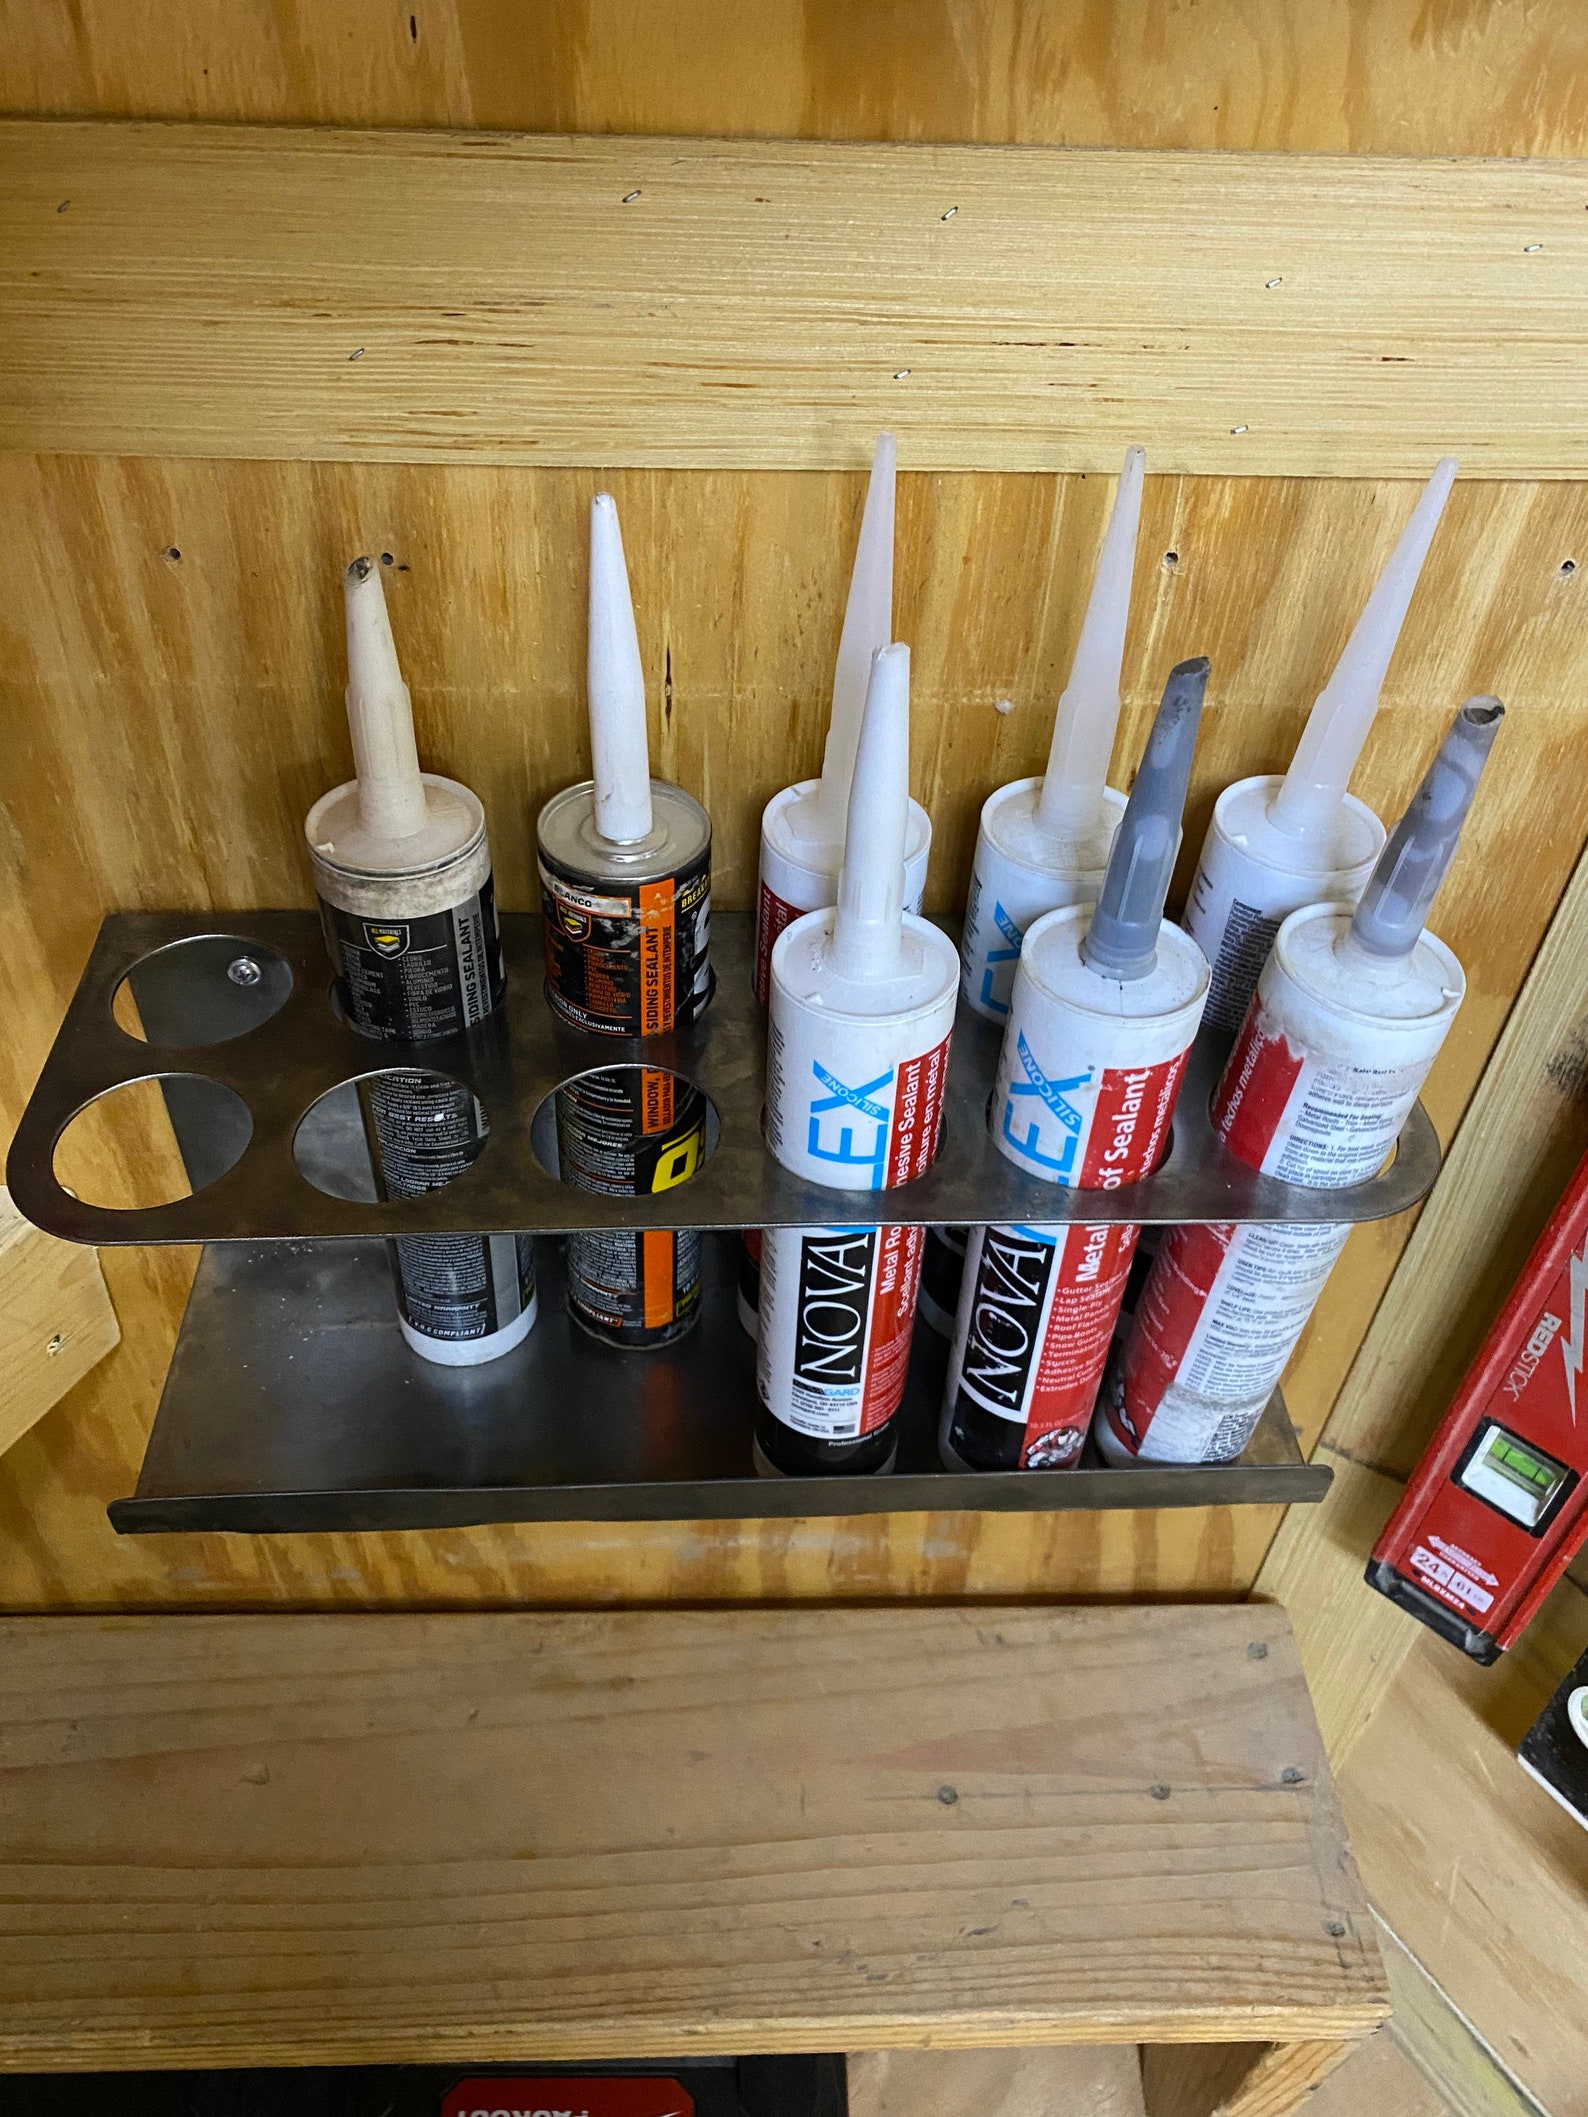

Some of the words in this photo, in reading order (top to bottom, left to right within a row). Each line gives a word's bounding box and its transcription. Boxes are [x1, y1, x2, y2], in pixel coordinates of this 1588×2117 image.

[761, 889, 771, 957] Sealant
[458, 918, 476, 981] SEALANT
[662, 925, 672, 963] INTEMPERIE
[402, 955, 422, 963] CEDRO
[645, 927, 660, 987] SEALANT
[405, 967, 449, 979] FIBROCEMENTO
[466, 982, 482, 1026] SIDING
[568, 1005, 588, 1019] ONLY
[645, 989, 659, 1029] SIDING
[575, 1016, 626, 1032] EXCLUSIVAMENTE
[925, 1049, 941, 1100] métal
[1019, 1042, 1081, 1127] SILICONE
[1221, 1087, 1243, 1132] techos
[1239, 1031, 1265, 1090] metálico
[820, 1072, 882, 1116] SILICONE
[898, 1060, 921, 1132] Sealant
[388, 1112, 412, 1122] BEST
[414, 1112, 458, 1123] RESTS
[923, 1101, 934, 1124] en
[1104, 1071, 1150, 1161] Sealant
[1142, 1127, 1162, 1173] techos
[1153, 1062, 1179, 1127] metálicos
[1303, 1102, 1349, 1119] Recommended
[1099, 1168, 1124, 1190] of
[885, 1227, 901, 1249] Ro
[1075, 1225, 1110, 1282] Metal
[880, 1250, 899, 1295] Metal
[897, 1260, 914, 1317] Scellant
[1061, 1286, 1092, 1295] Gutter
[433, 1303, 480, 1311] WARRANTY
[801, 1233, 869, 1377] NOVA
[1058, 1300, 1103, 1314] Single-Ply
[1059, 1296, 1078, 1305] Lap
[966, 1238, 1047, 1403] NOVA
[1054, 1322, 1076, 1332] Roof
[1055, 1312, 1083, 1323] Metal
[433, 1328, 481, 1337] COMPLIANT
[1051, 1333, 1073, 1341] Pipe
[1050, 1341, 1076, 1350] Snow
[1502, 1311, 1563, 1398] REDSTICK
[1040, 1381, 1079, 1393] Extrudes
[1042, 1374, 1076, 1384] Neutral
[828, 1434, 873, 1447] Professional
[1416, 1553, 1440, 1573] 24
[1456, 1581, 1472, 1596] 61
